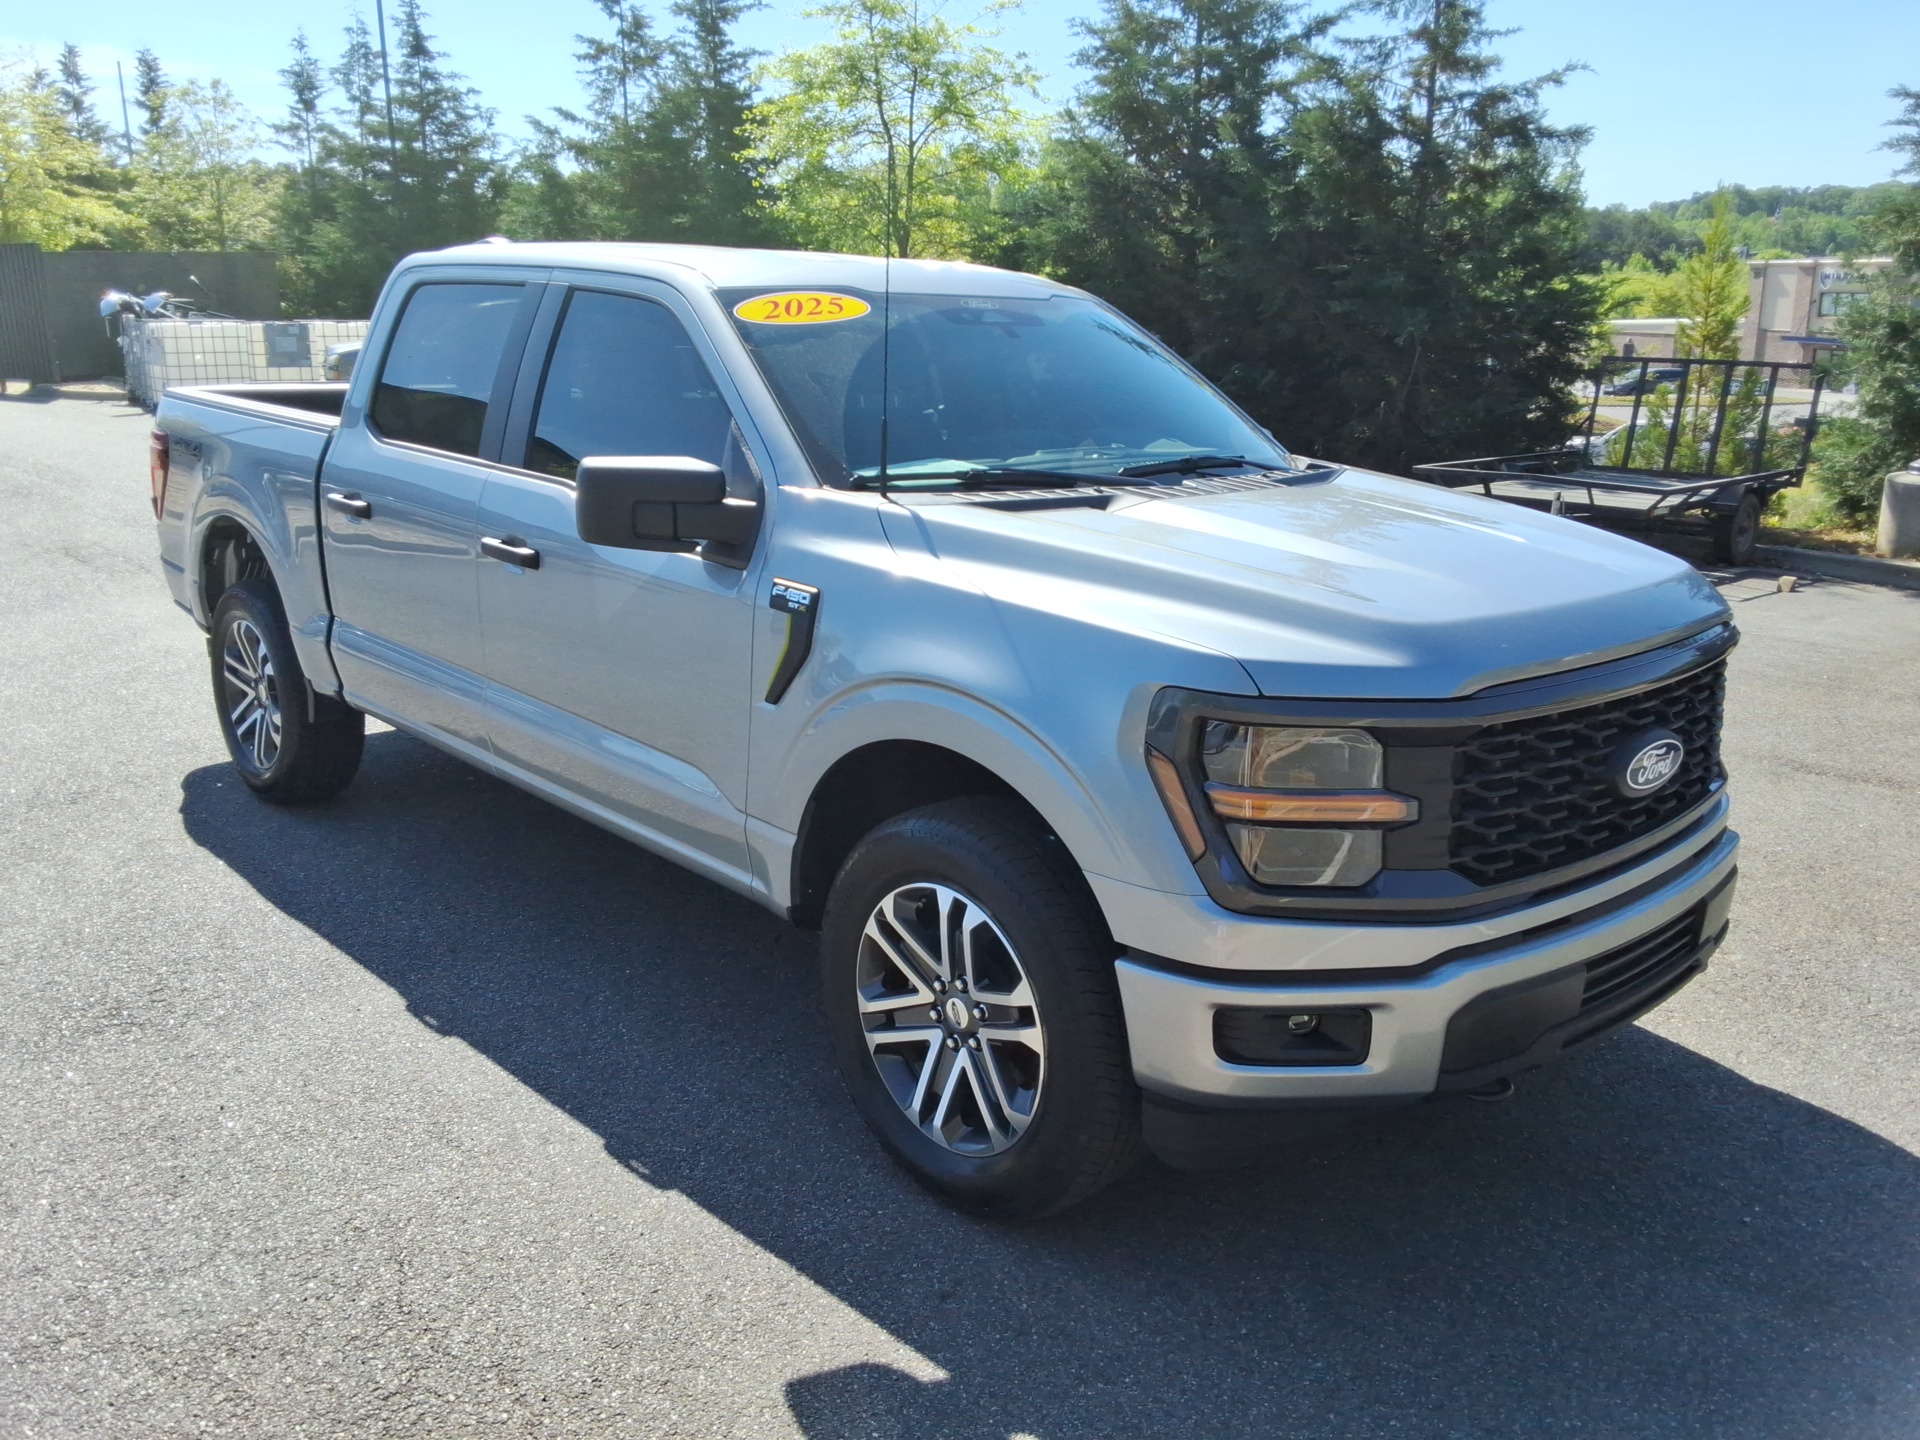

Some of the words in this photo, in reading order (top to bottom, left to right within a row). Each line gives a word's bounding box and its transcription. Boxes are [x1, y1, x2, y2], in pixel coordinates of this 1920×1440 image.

[763, 297, 844, 320] 2025
[772, 585, 811, 605] F-150
[787, 601, 808, 613] STX
[1637, 746, 1674, 784] Ford
